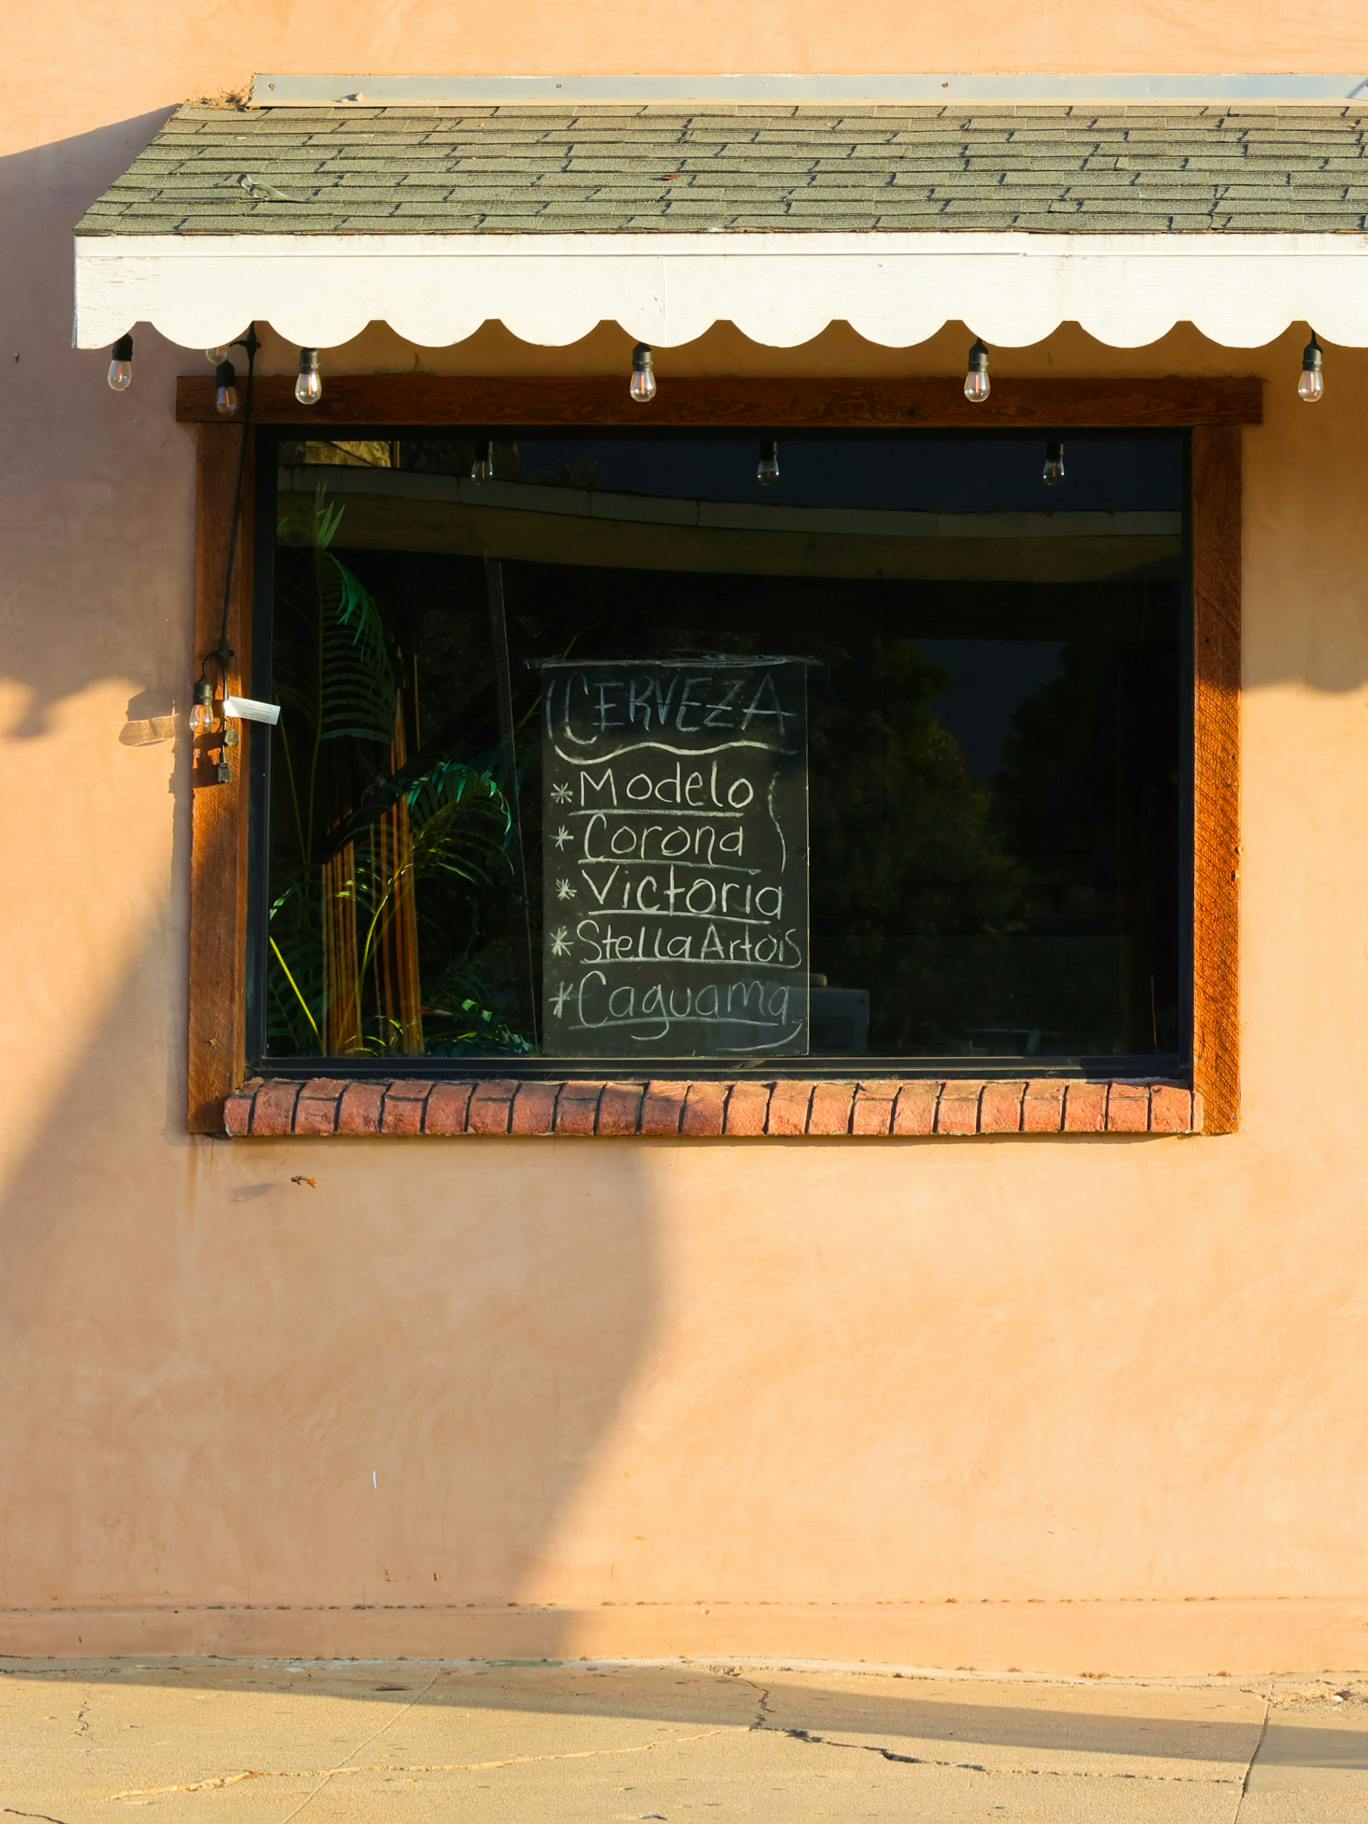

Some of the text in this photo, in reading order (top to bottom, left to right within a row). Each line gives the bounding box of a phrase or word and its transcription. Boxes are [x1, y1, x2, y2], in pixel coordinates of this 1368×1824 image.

[560, 672, 796, 744] CERVEZA
[580, 761, 754, 808] Modelo
[583, 814, 744, 866] Corona
[581, 864, 783, 921] Victoria
[576, 920, 802, 967] Stella Artois
[578, 970, 790, 1041] Caguama
